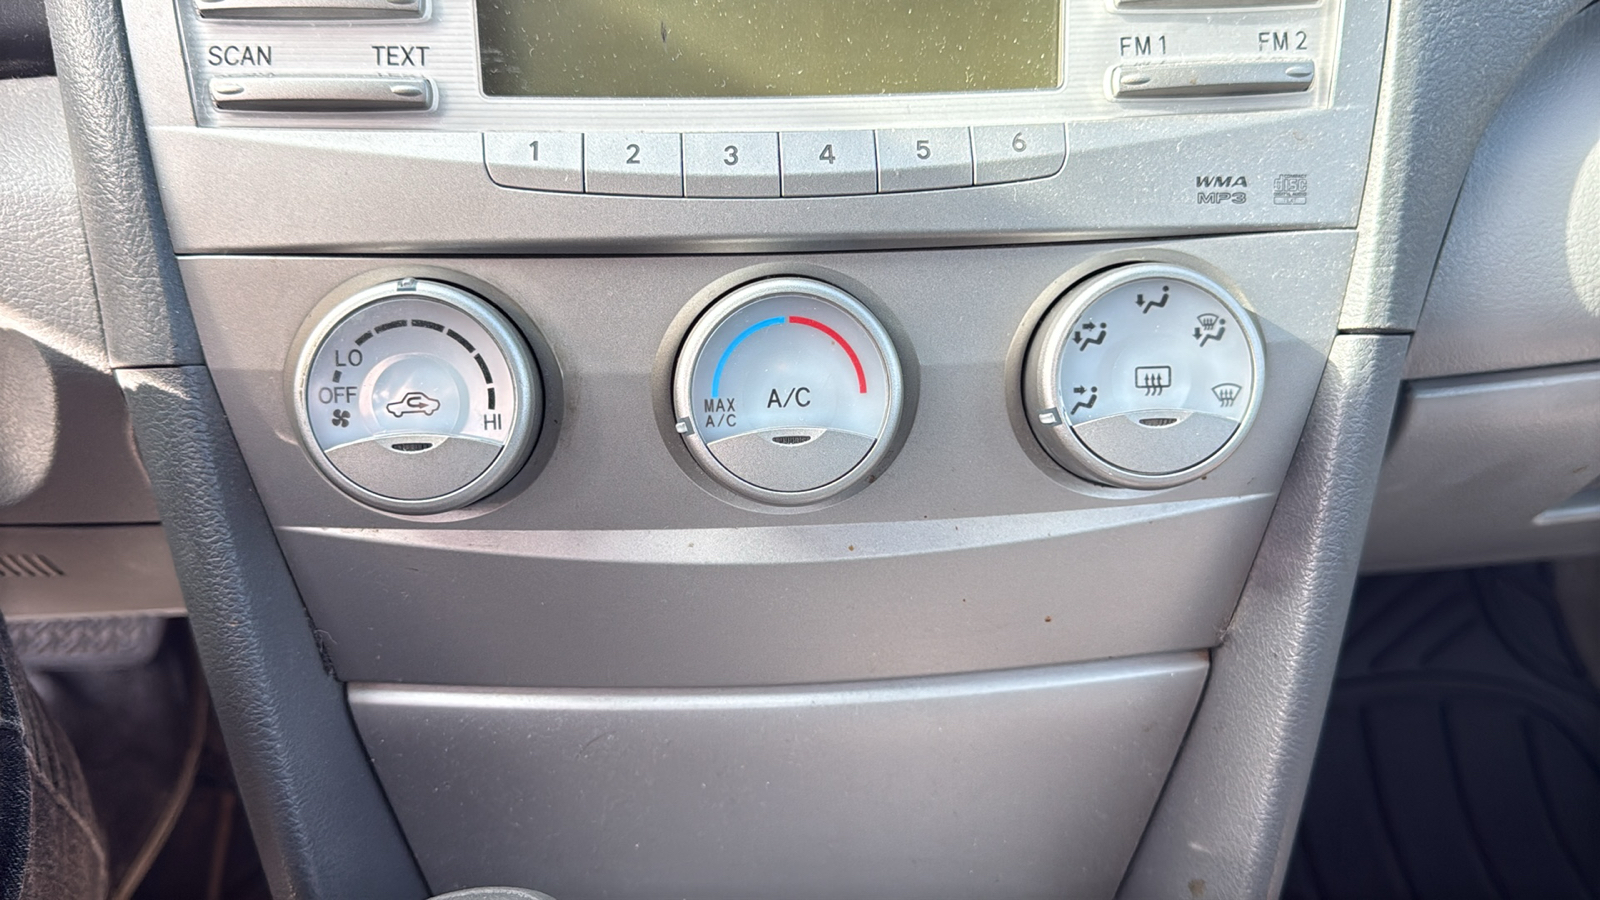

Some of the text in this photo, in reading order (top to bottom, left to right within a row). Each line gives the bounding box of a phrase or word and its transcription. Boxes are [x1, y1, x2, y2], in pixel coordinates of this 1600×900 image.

[208, 45, 273, 66] SCAN
[371, 45, 431, 66] TEXT
[529, 141, 540, 161] 1
[916, 139, 931, 160] 5
[1012, 132, 1027, 152] 6
[626, 144, 641, 164] 2
[723, 145, 739, 165] 3
[819, 144, 836, 164] 4
[1196, 176, 1248, 188] WMA
[1197, 192, 1247, 204] MP3
[335, 349, 363, 367] LO
[318, 386, 358, 404] OFF
[767, 387, 811, 408] A/C
[704, 398, 736, 413] MAX
[483, 413, 502, 430] HI
[705, 414, 737, 428] A/C
